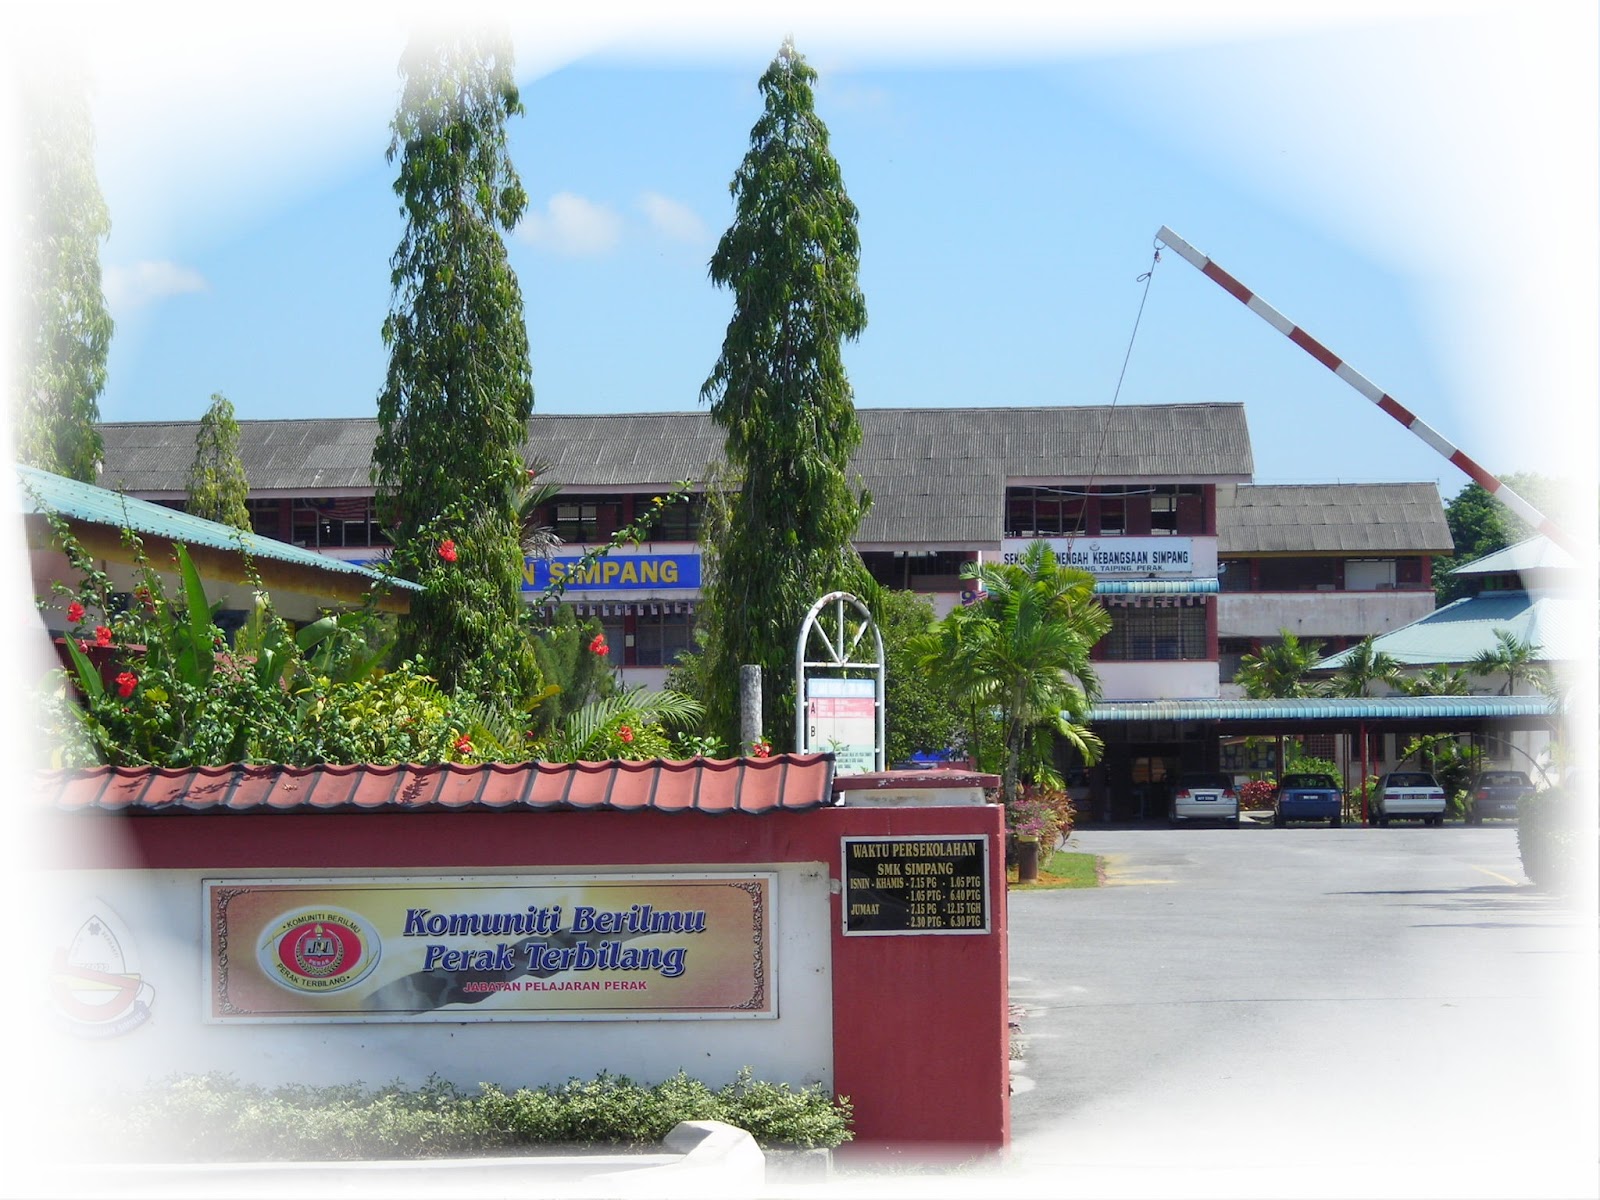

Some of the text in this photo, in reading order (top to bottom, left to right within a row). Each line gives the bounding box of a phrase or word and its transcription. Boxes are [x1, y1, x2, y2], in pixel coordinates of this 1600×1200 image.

[1004, 552, 1041, 565] SEKO
[1092, 551, 1148, 564] KEBANGSAAN
[1152, 551, 1188, 563] SIMPANG
[549, 560, 678, 585] SIMPANG
[810, 703, 816, 714] A
[810, 726, 816, 737] B
[853, 842, 976, 858] WAKTU PERSEKOLAHAN
[878, 862, 954, 875] SMK SIMPANG
[850, 878, 870, 889] ISNIN
[876, 877, 904, 889] KHAMIS
[910, 877, 925, 888] 7.15
[926, 877, 937, 888] PG
[950, 876, 965, 888] 1.05
[965, 876, 981, 887] PTG
[910, 890, 925, 901] 1.05
[926, 890, 941, 901] PTG
[950, 889, 965, 900] 6.40
[966, 889, 981, 900] PTG
[851, 904, 880, 915] JUMAAT
[911, 903, 925, 914] 7.15
[926, 903, 937, 914] PG
[947, 903, 965, 913] 12.15
[966, 902, 981, 913] TGH
[286, 913, 361, 934] KOMUNITI BERILMU
[403, 904, 706, 936] Komuniti Berilmu
[911, 916, 925, 927] 2.30
[926, 916, 942, 927] PTG
[950, 915, 965, 927] 6.30
[966, 915, 981, 926] PTG
[422, 939, 688, 978] Perak Terbilang
[276, 962, 346, 988] PERAK TERBILANG
[463, 980, 648, 992] JABATAN PELAJARAN PERAK
